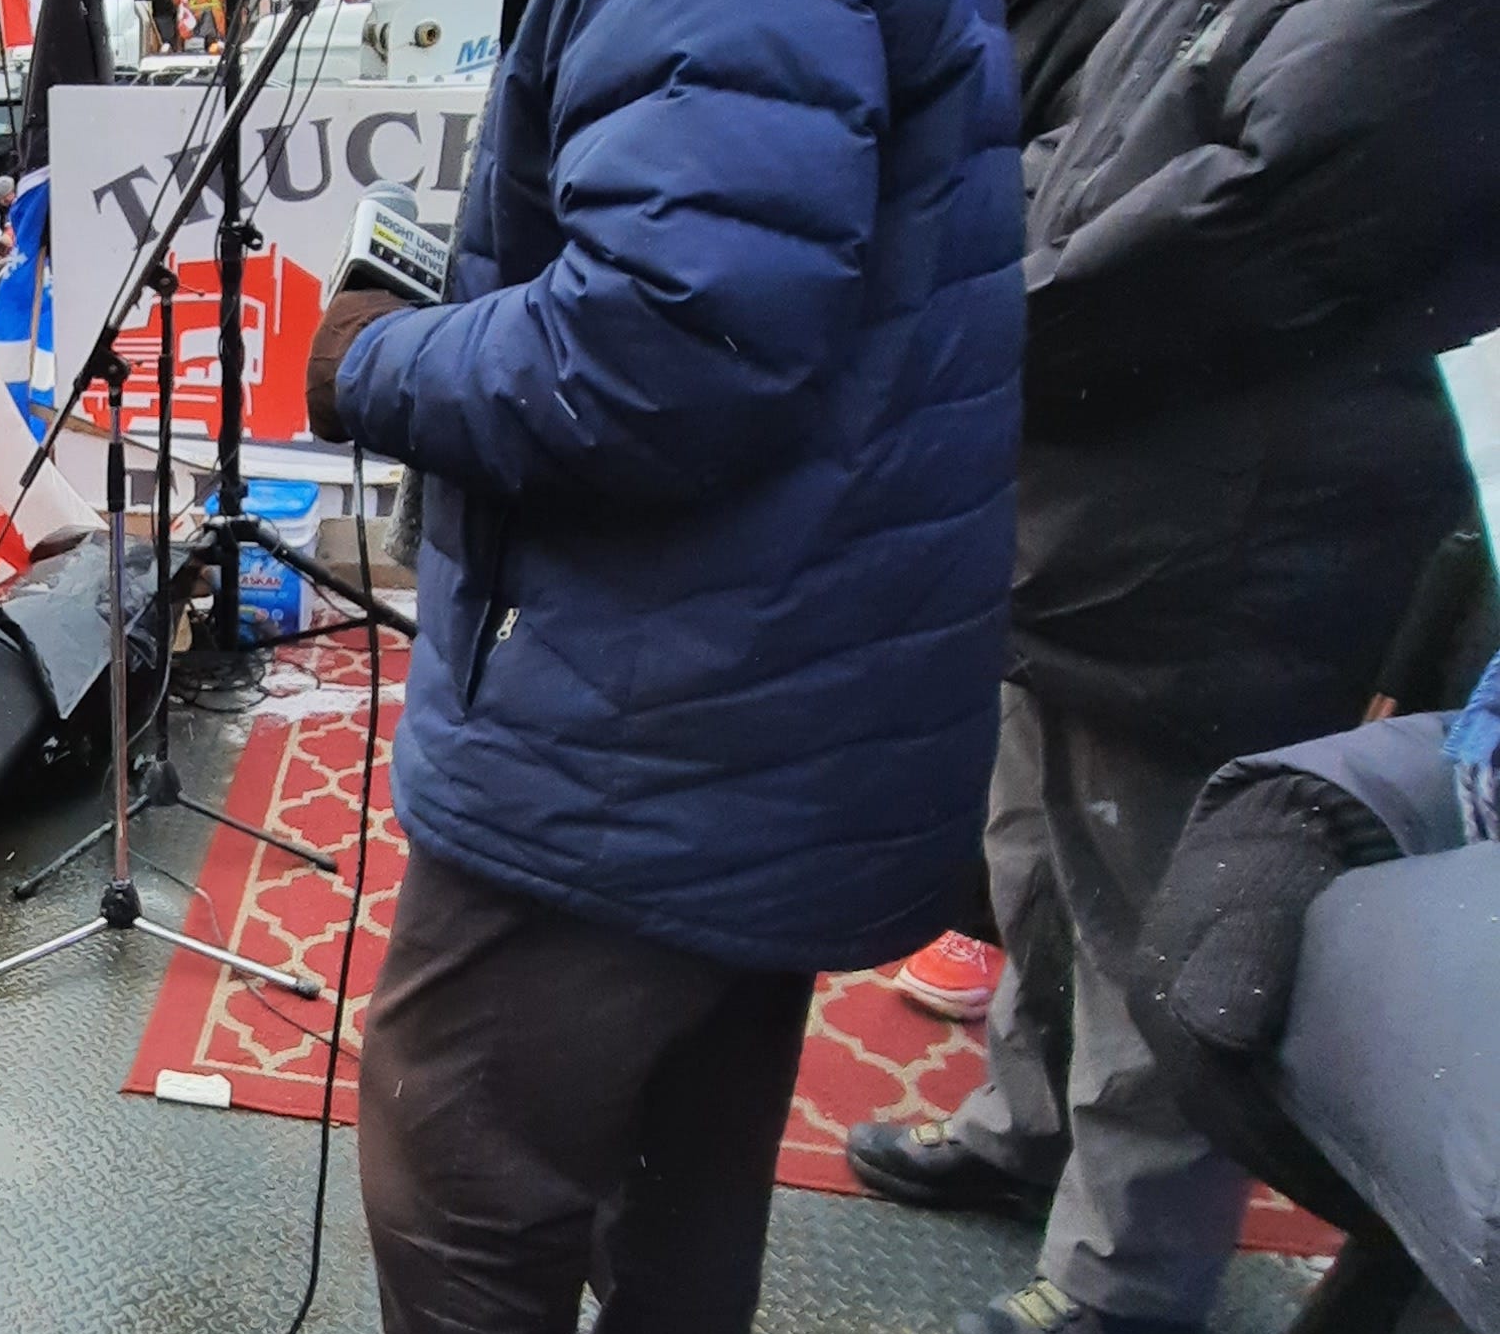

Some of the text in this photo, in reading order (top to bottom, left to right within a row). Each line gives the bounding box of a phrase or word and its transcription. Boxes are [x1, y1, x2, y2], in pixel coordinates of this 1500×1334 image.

[375, 211, 414, 242] BRIGHT
[415, 234, 447, 262] LIGHT
[414, 249, 445, 276] NEWS
